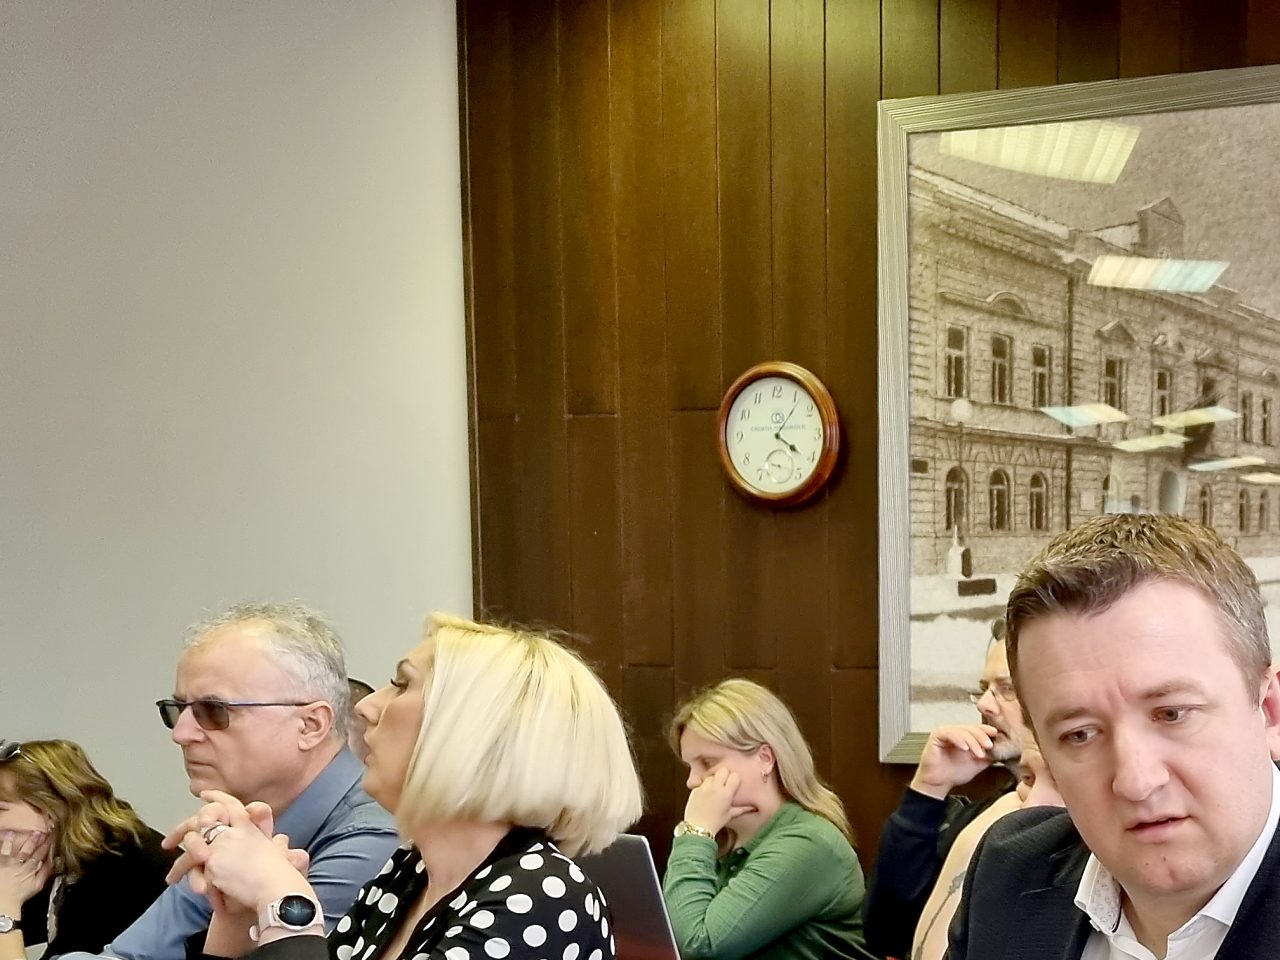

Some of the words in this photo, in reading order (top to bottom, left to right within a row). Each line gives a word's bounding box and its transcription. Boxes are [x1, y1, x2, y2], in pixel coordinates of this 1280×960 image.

[754, 391, 762, 405] 11
[772, 385, 783, 399] 12
[740, 408, 750, 421] 10
[806, 404, 814, 417] 2
[736, 431, 744, 443] 9
[815, 428, 822, 440] 3
[743, 453, 751, 465] 8
[807, 451, 816, 463] 4
[756, 468, 766, 481] 7
[794, 468, 802, 480] 5
